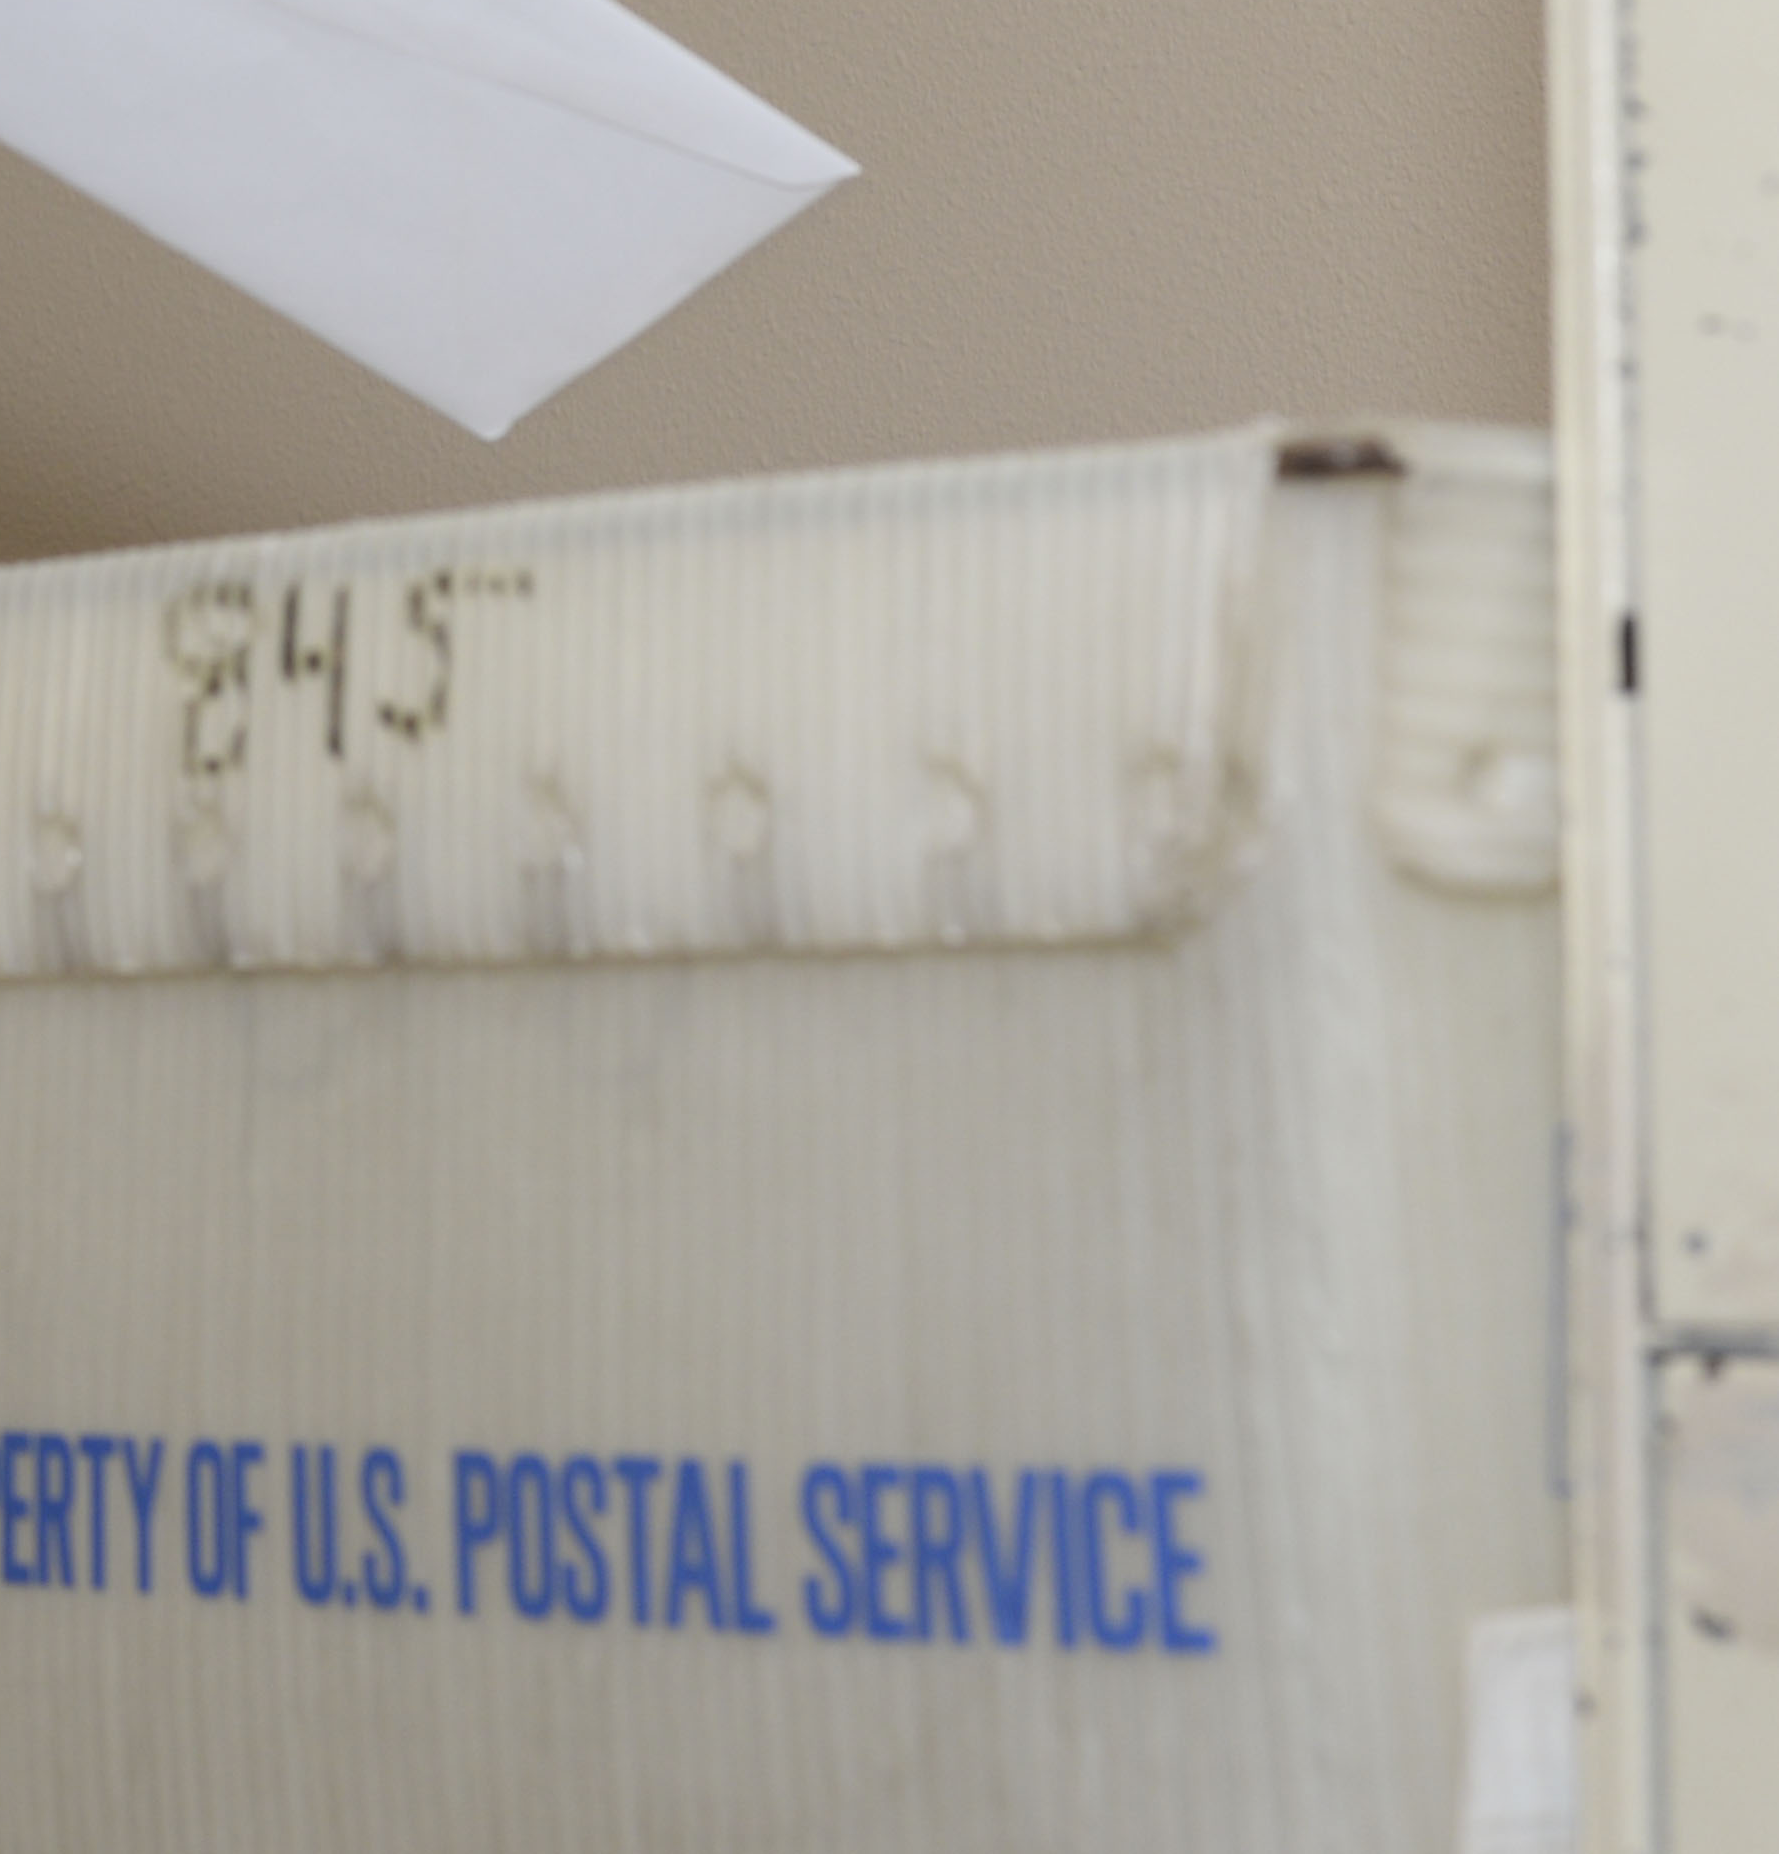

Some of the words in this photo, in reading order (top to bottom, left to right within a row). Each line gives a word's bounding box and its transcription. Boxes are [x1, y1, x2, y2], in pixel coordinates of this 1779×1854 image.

[186, 1439, 267, 1601] OF
[291, 1443, 432, 1615] U.S.
[453, 1449, 778, 1635] POSTAL
[799, 1462, 1219, 1656] SERVICE
